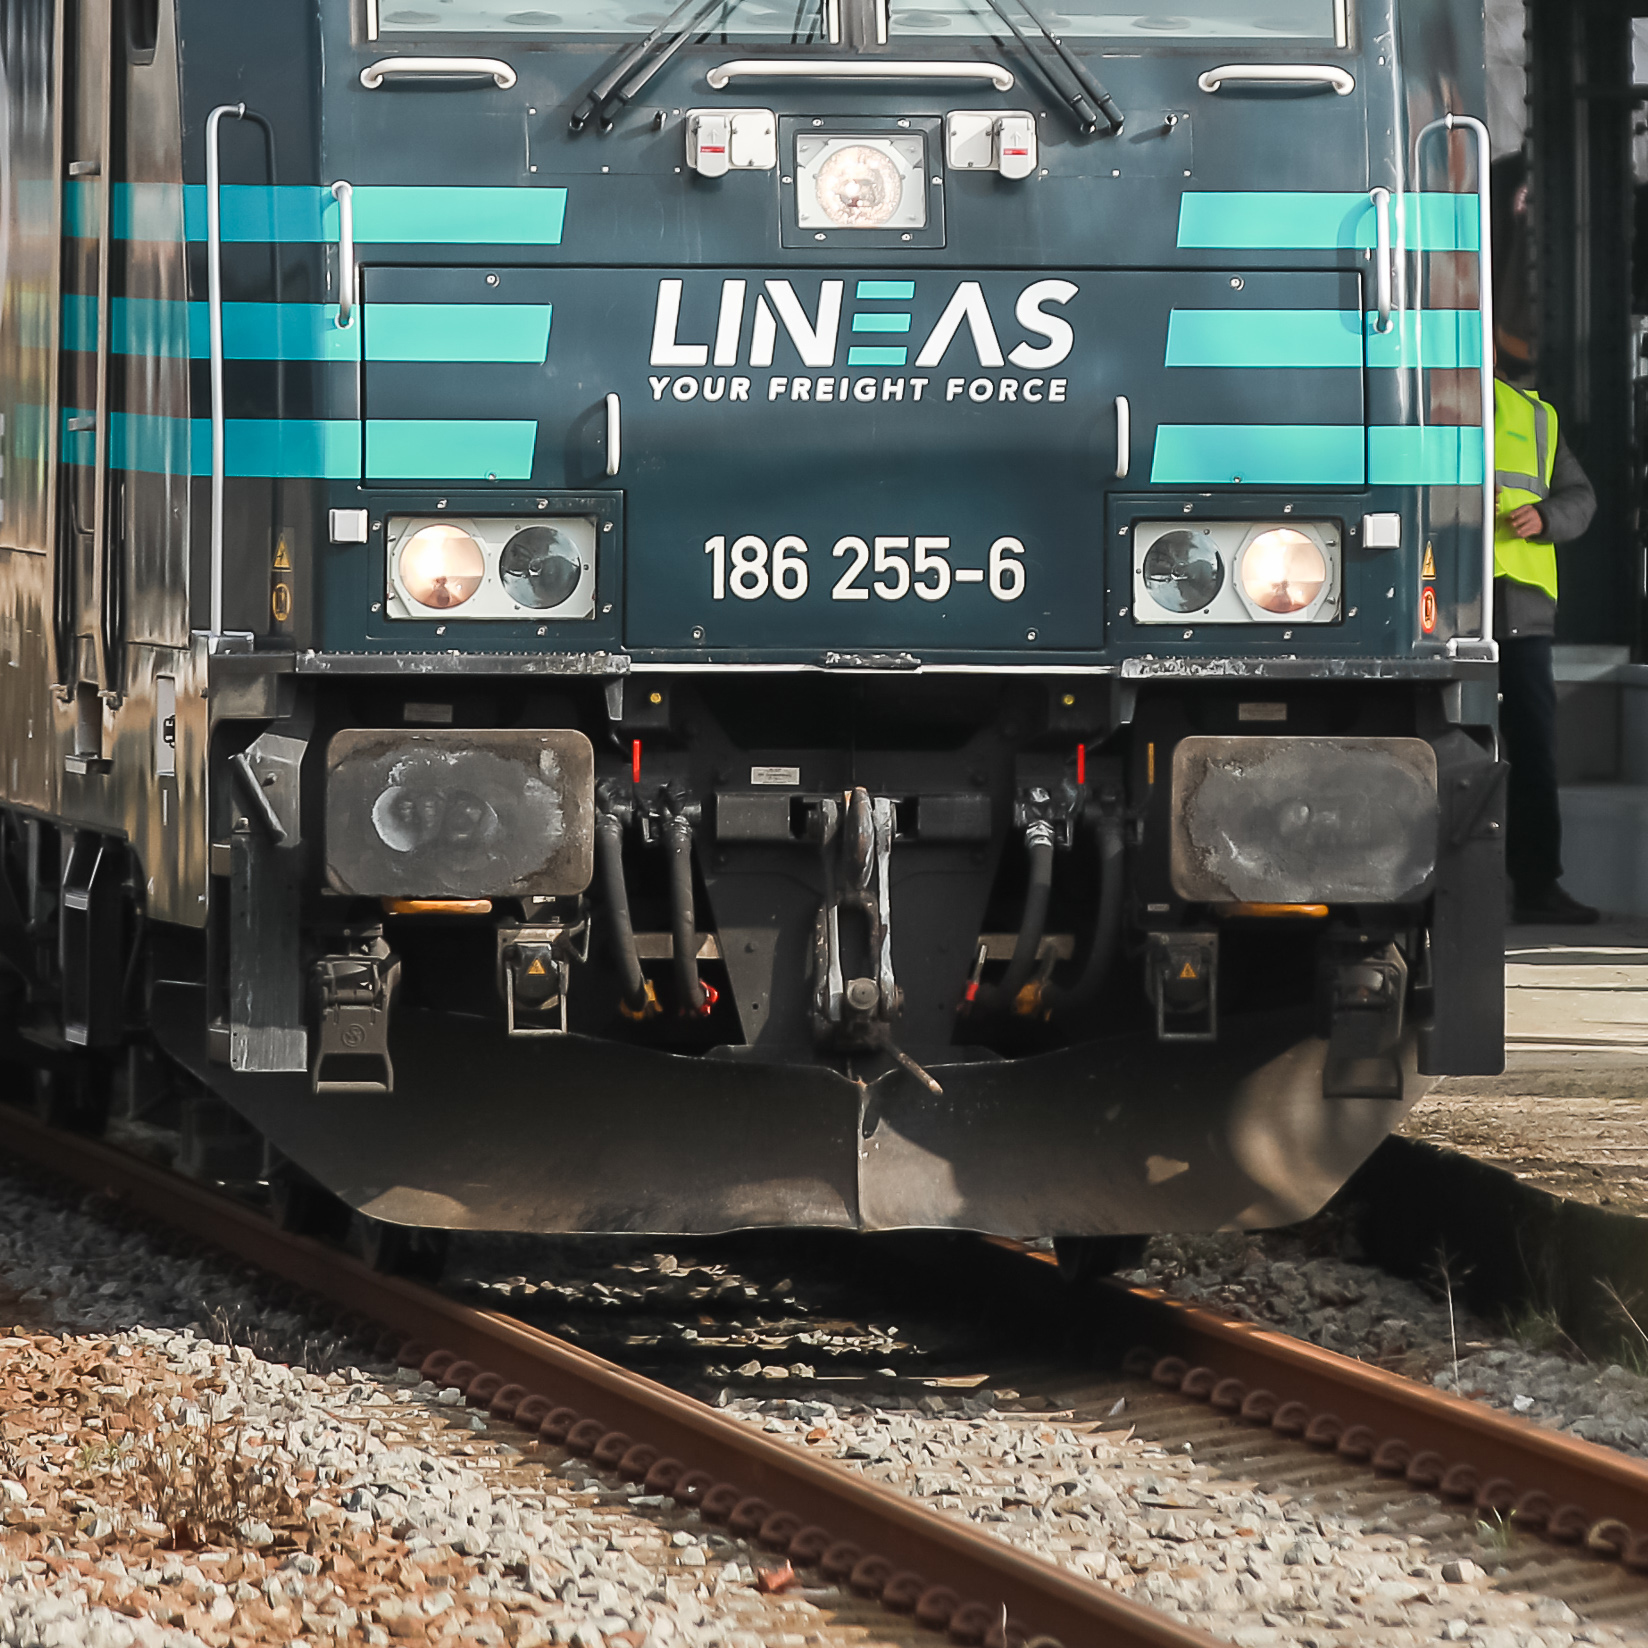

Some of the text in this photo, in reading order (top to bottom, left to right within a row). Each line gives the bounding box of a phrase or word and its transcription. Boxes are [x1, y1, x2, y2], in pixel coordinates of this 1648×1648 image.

[650, 278, 1080, 370] LINEAS
[649, 376, 1068, 403] YOUR FREIGHT FORCE
[705, 535, 1025, 600] 186 255-6
